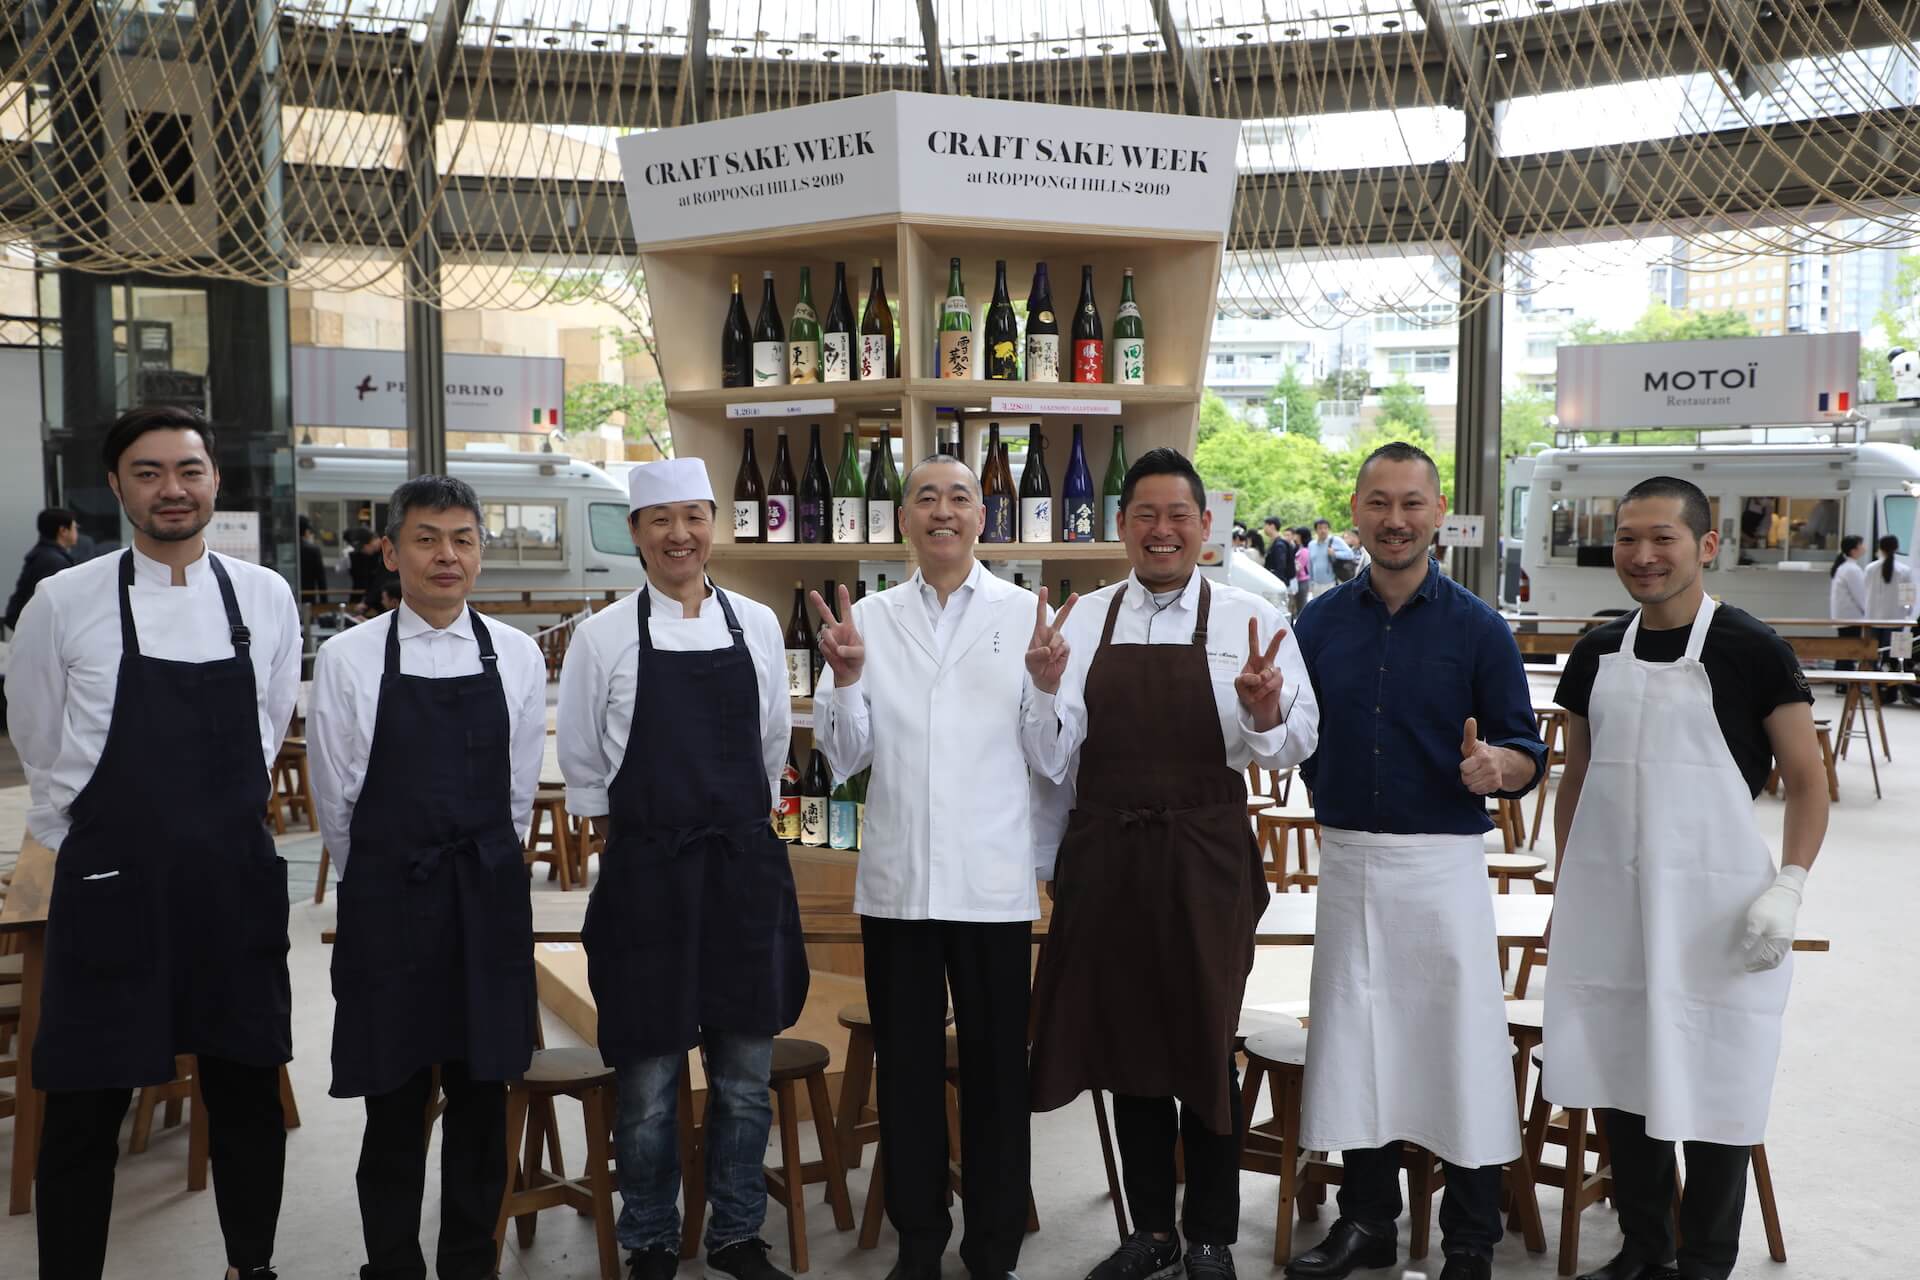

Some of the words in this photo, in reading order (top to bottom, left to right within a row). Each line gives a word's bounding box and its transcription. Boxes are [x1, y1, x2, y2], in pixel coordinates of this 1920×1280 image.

[645, 154, 721, 186] CRAFT
[725, 144, 791, 175] SAKE
[793, 130, 876, 165] WEEK
[927, 130, 1030, 161] CRAFT
[1035, 137, 1114, 167] SAKE
[1121, 144, 1209, 174] WEEK
[678, 195, 691, 207] at
[693, 181, 765, 206] ROPPONGI
[767, 176, 811, 196] HILLS
[811, 172, 845, 189] 2019
[967, 171, 982, 184] at
[987, 171, 1078, 191] ROPPONGI
[1081, 177, 1132, 194] HILLS
[1134, 181, 1171, 197] 2019
[386, 380, 504, 397] PEGRINO
[1644, 361, 1758, 392] MOTOÏ
[1666, 395, 1731, 407] Restaurant
